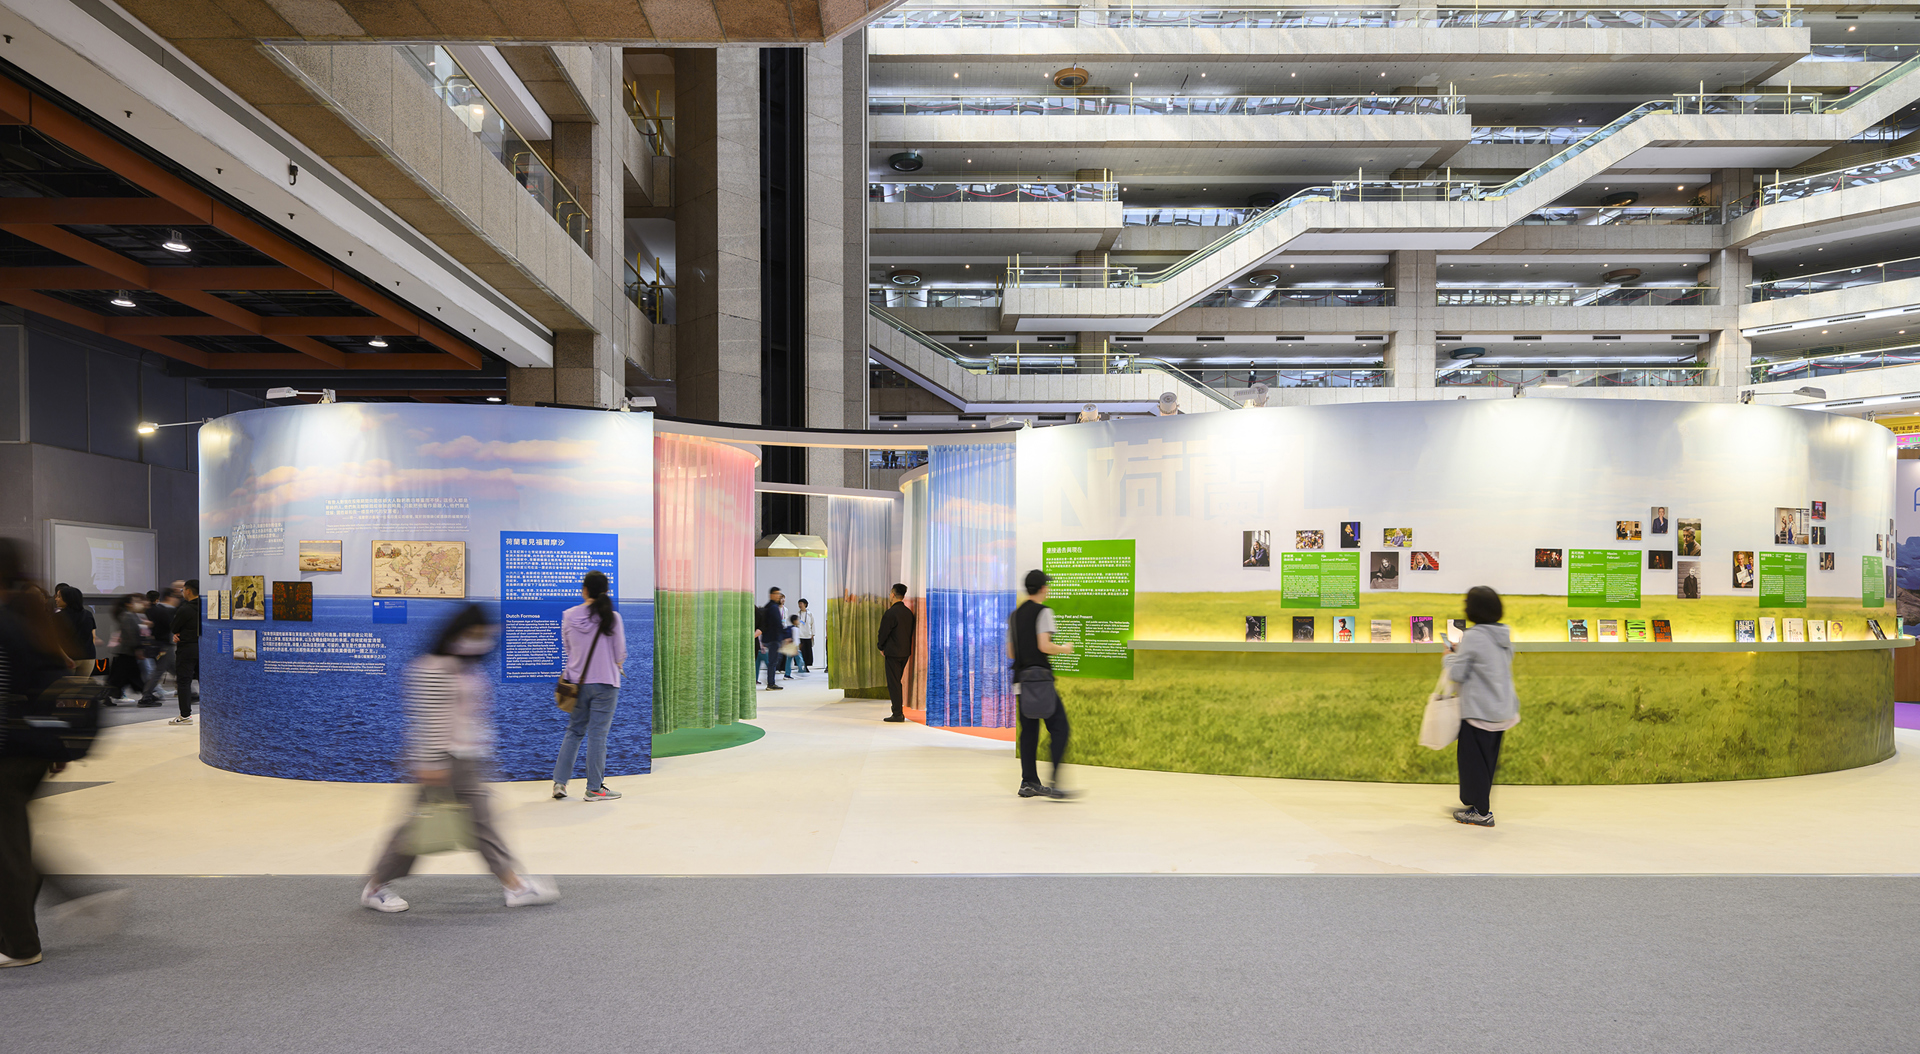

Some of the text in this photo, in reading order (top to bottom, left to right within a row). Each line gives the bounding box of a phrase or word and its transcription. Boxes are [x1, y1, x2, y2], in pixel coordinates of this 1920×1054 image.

[1097, 435, 1279, 523] 荷蘭
[505, 538, 565, 546] 荷蘭看見福爾摩沙
